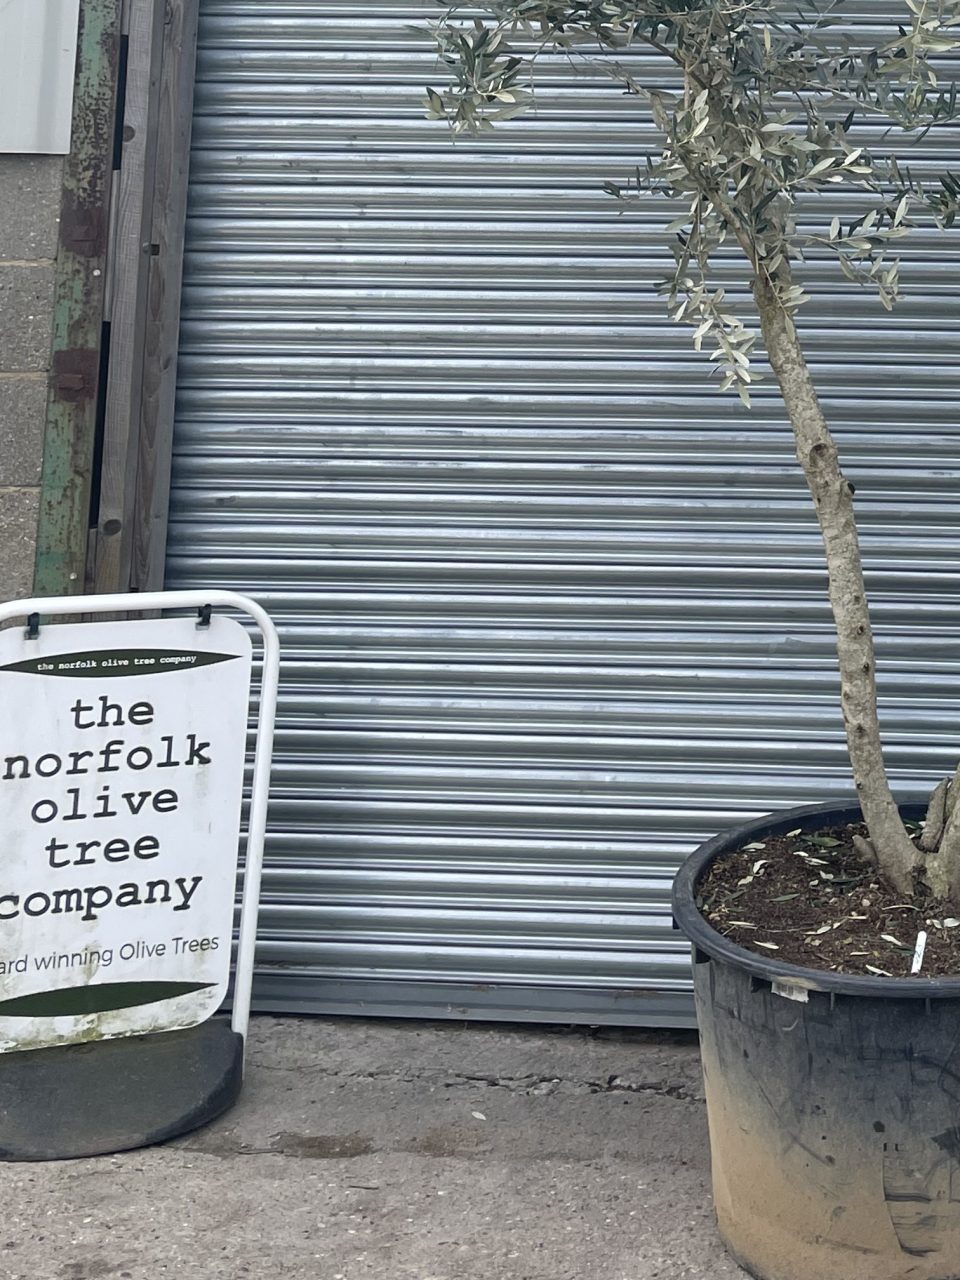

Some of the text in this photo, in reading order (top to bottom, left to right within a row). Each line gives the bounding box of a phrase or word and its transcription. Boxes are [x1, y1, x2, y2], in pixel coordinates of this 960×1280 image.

[37, 656, 197, 671] the norfolk olive tree company
[71, 695, 154, 729] the
[2, 734, 212, 780] norfolk
[31, 785, 178, 823] olive
[45, 834, 160, 868] tree
[0, 876, 202, 921] company
[34, 946, 113, 969] winning
[119, 940, 166, 961] Olive
[172, 936, 219, 956] Trees
